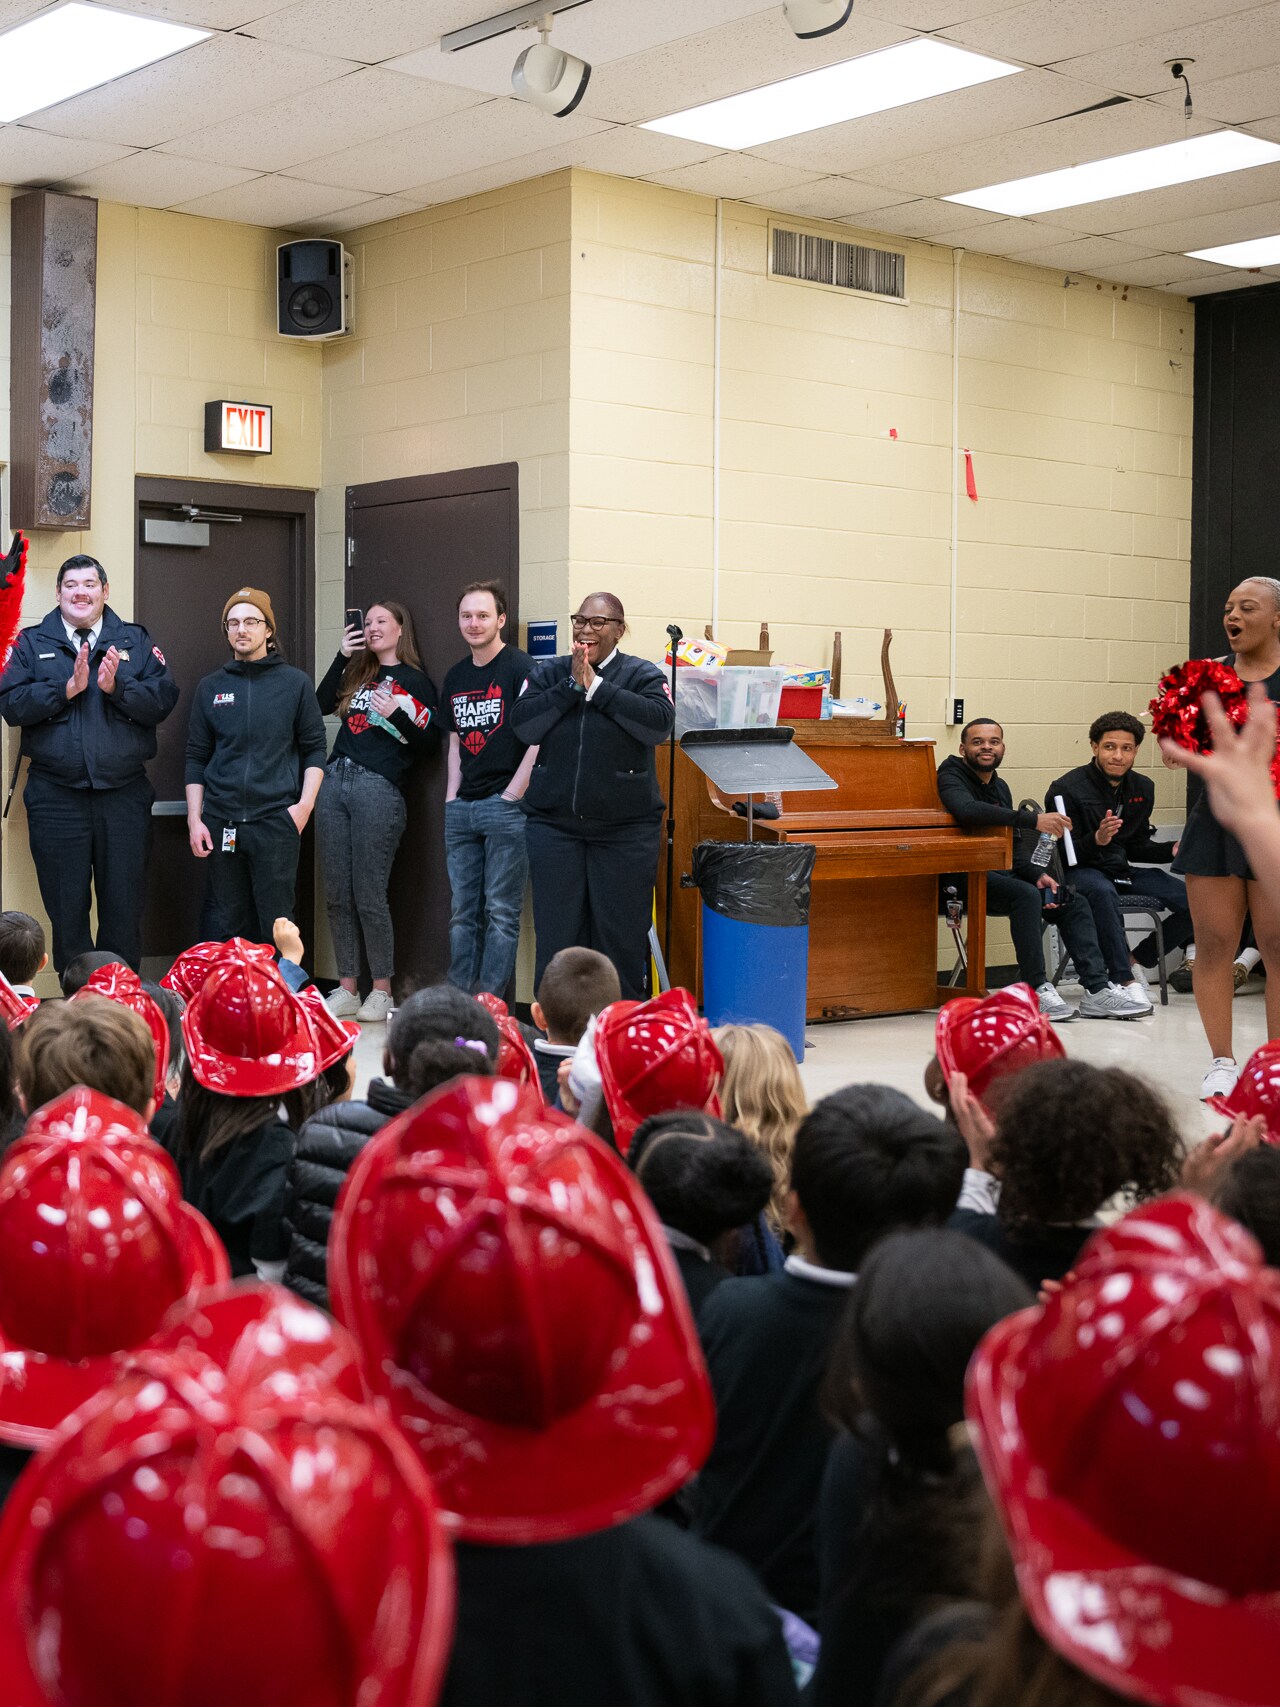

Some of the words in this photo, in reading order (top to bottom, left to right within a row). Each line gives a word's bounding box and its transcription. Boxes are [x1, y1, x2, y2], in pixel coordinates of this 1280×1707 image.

[226, 407, 266, 448] EXIT
[350, 698, 371, 711] SAF
[454, 698, 501, 718] CHARGE
[460, 712, 500, 728] SAFETY
